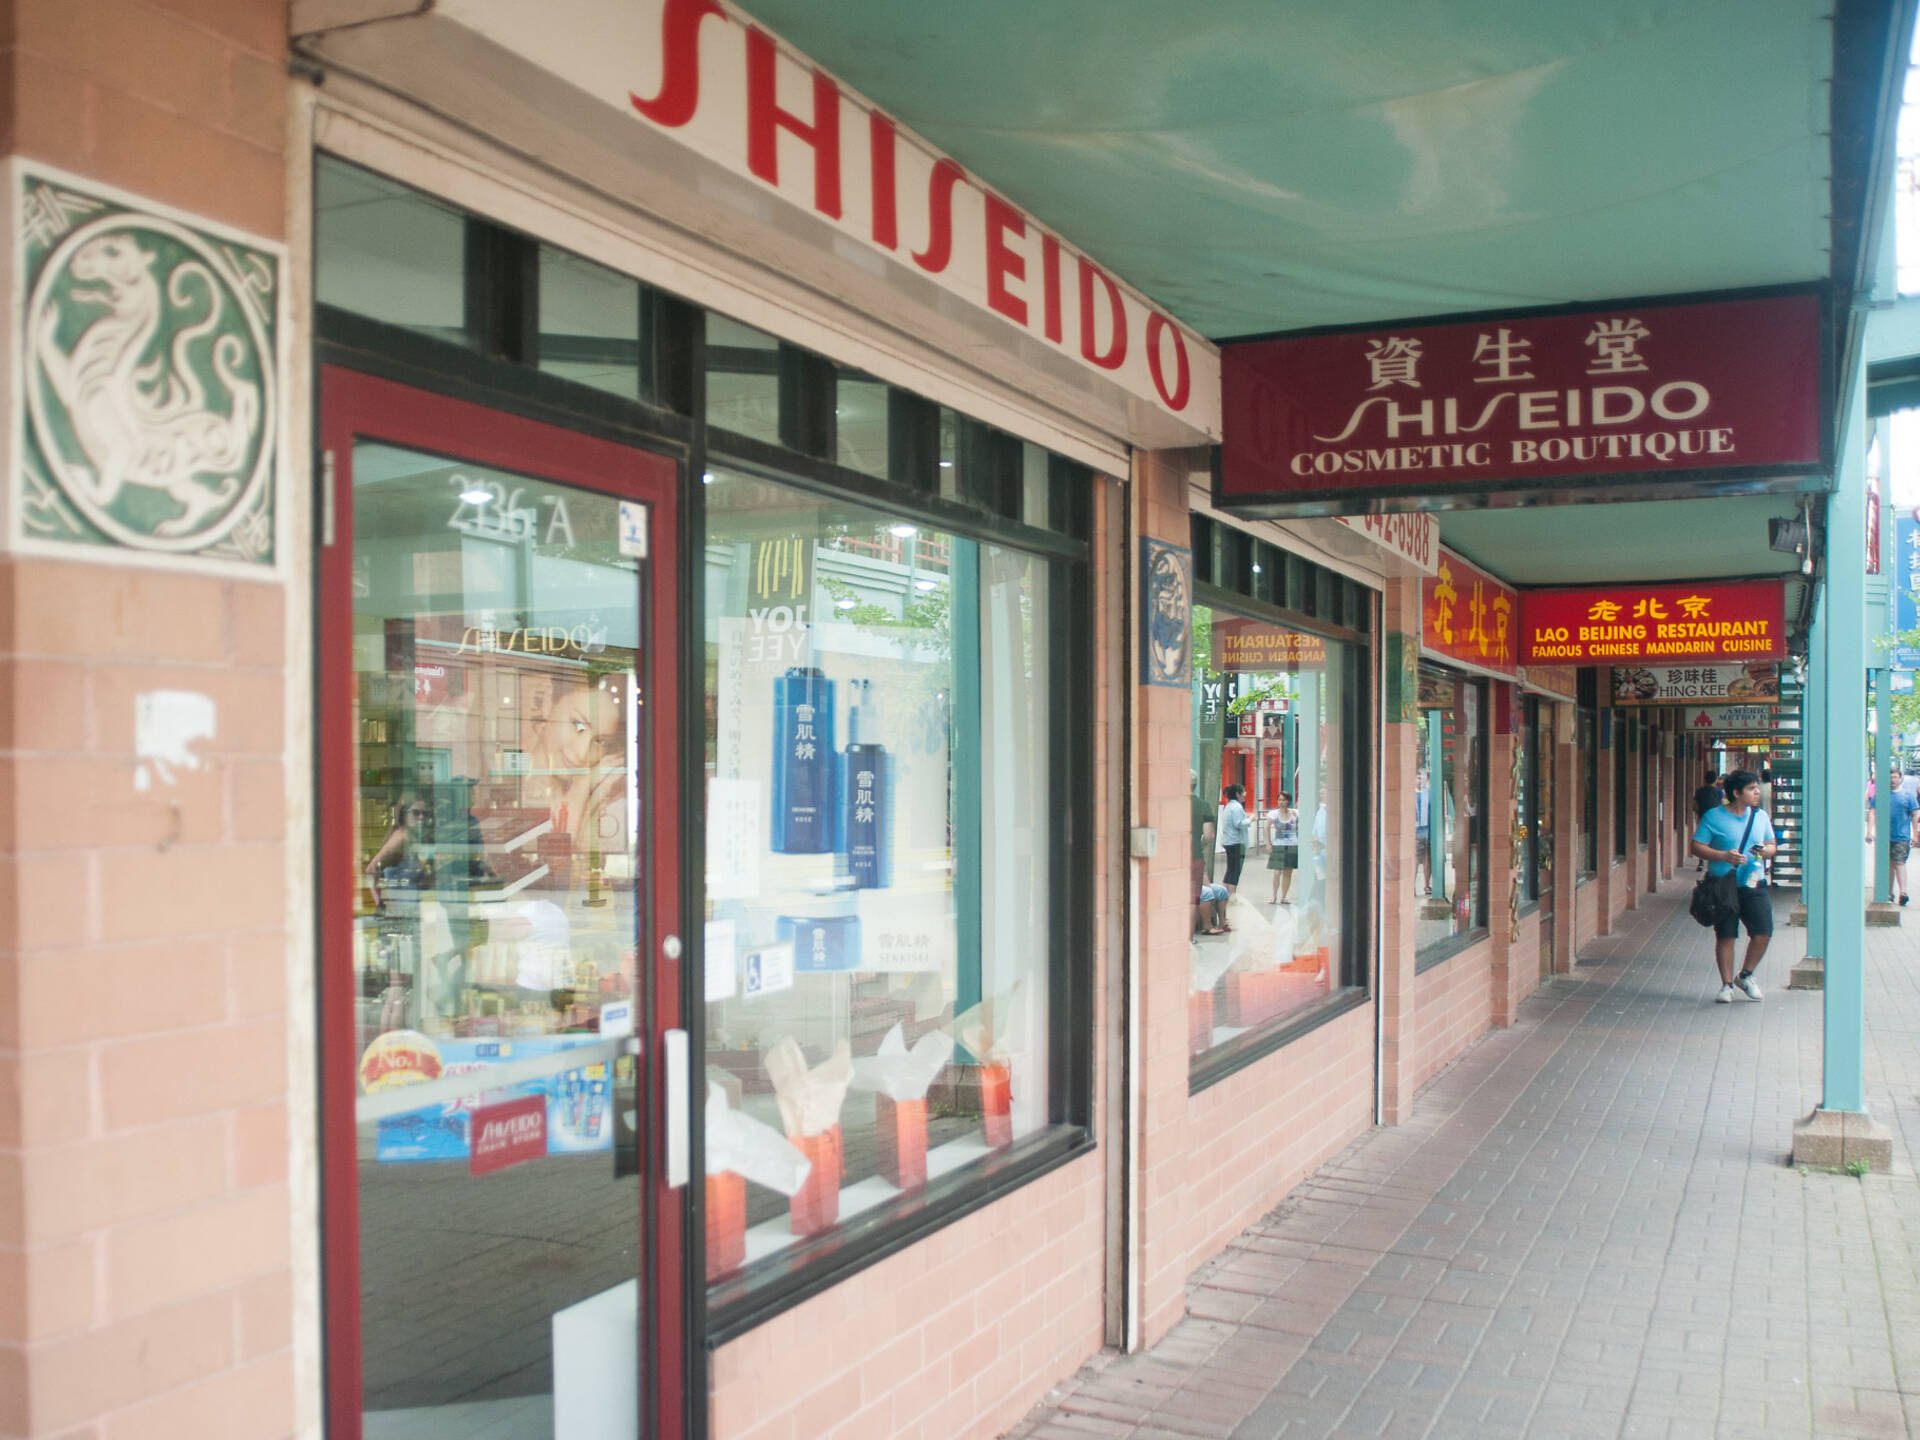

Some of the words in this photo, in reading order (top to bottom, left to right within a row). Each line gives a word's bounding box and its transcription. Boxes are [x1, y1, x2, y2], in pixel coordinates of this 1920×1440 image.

[628, 0, 1191, 412] SHISEIDO
[1363, 318, 1652, 391] 資生堂
[1312, 380, 1711, 443] SHISEIDO
[1289, 441, 1492, 477] COSMETIC
[1510, 426, 1736, 465] BOUTIQUE
[1433, 559, 1512, 665] 老北京
[1587, 595, 1713, 622] 老北京
[450, 625, 593, 656] SHISEIDO
[1532, 644, 1582, 658] FAMOUS
[1588, 642, 1640, 656] CHINESE
[1646, 640, 1715, 655] MANDARIN
[1722, 638, 1772, 652] CUISINE
[1535, 627, 1569, 643] LAO
[1578, 625, 1647, 641] BEIJING
[1656, 620, 1769, 639] RESTAURANT
[1659, 684, 1697, 697] HING
[1700, 684, 1726, 697] KEE
[1667, 668, 1717, 684] 珍味佳
[795, 704, 816, 760] 雪肌精
[855, 770, 875, 823] 雪肌精
[478, 1111, 542, 1142] SHISEIDO
